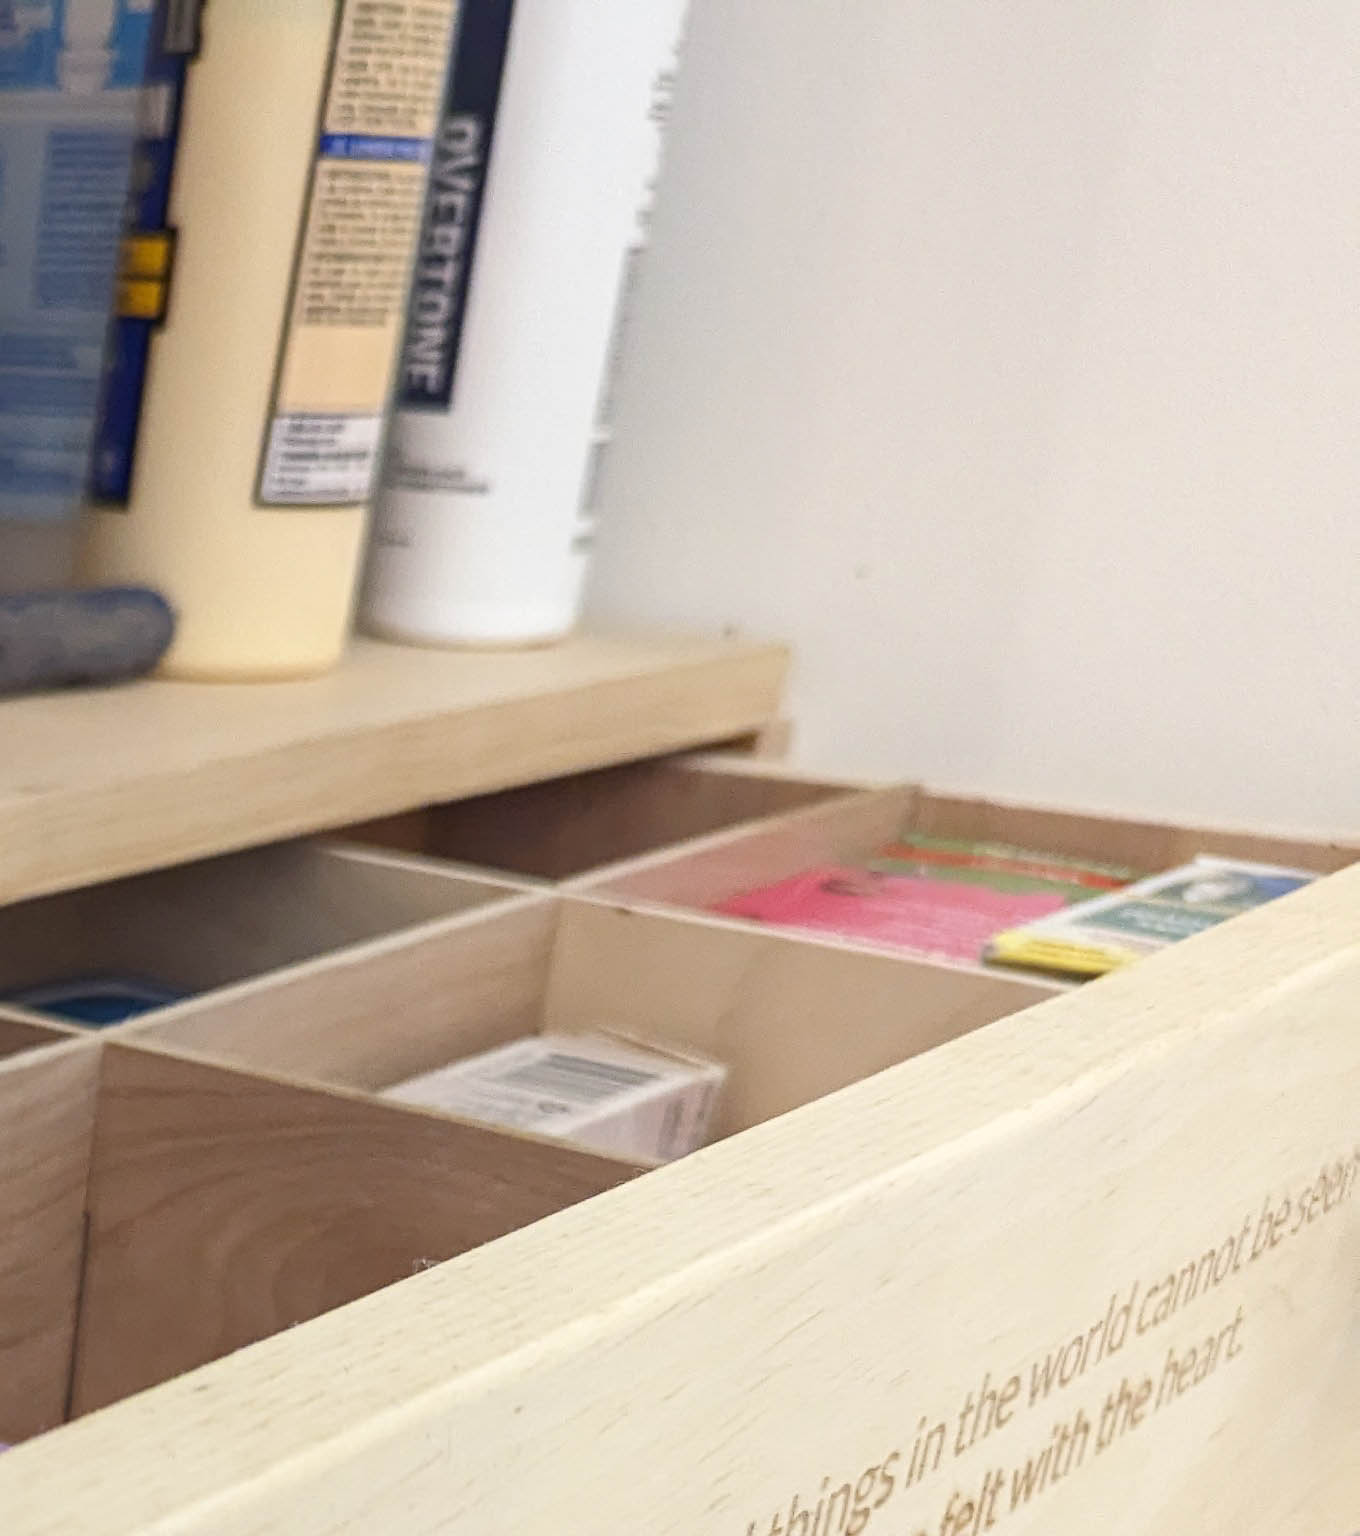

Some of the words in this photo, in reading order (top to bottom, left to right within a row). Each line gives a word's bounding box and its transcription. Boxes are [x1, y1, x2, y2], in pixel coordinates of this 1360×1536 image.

[409, 112, 484, 394] OVERTONE
[905, 1415, 947, 1489] in
[953, 1372, 1021, 1459] the
[1028, 1279, 1139, 1408] world
[1134, 1213, 1251, 1337] cannot
[1248, 1194, 1292, 1262] be
[1009, 1406, 1091, 1513] with
[1094, 1371, 1154, 1456] the
[1153, 1304, 1244, 1414] heart
